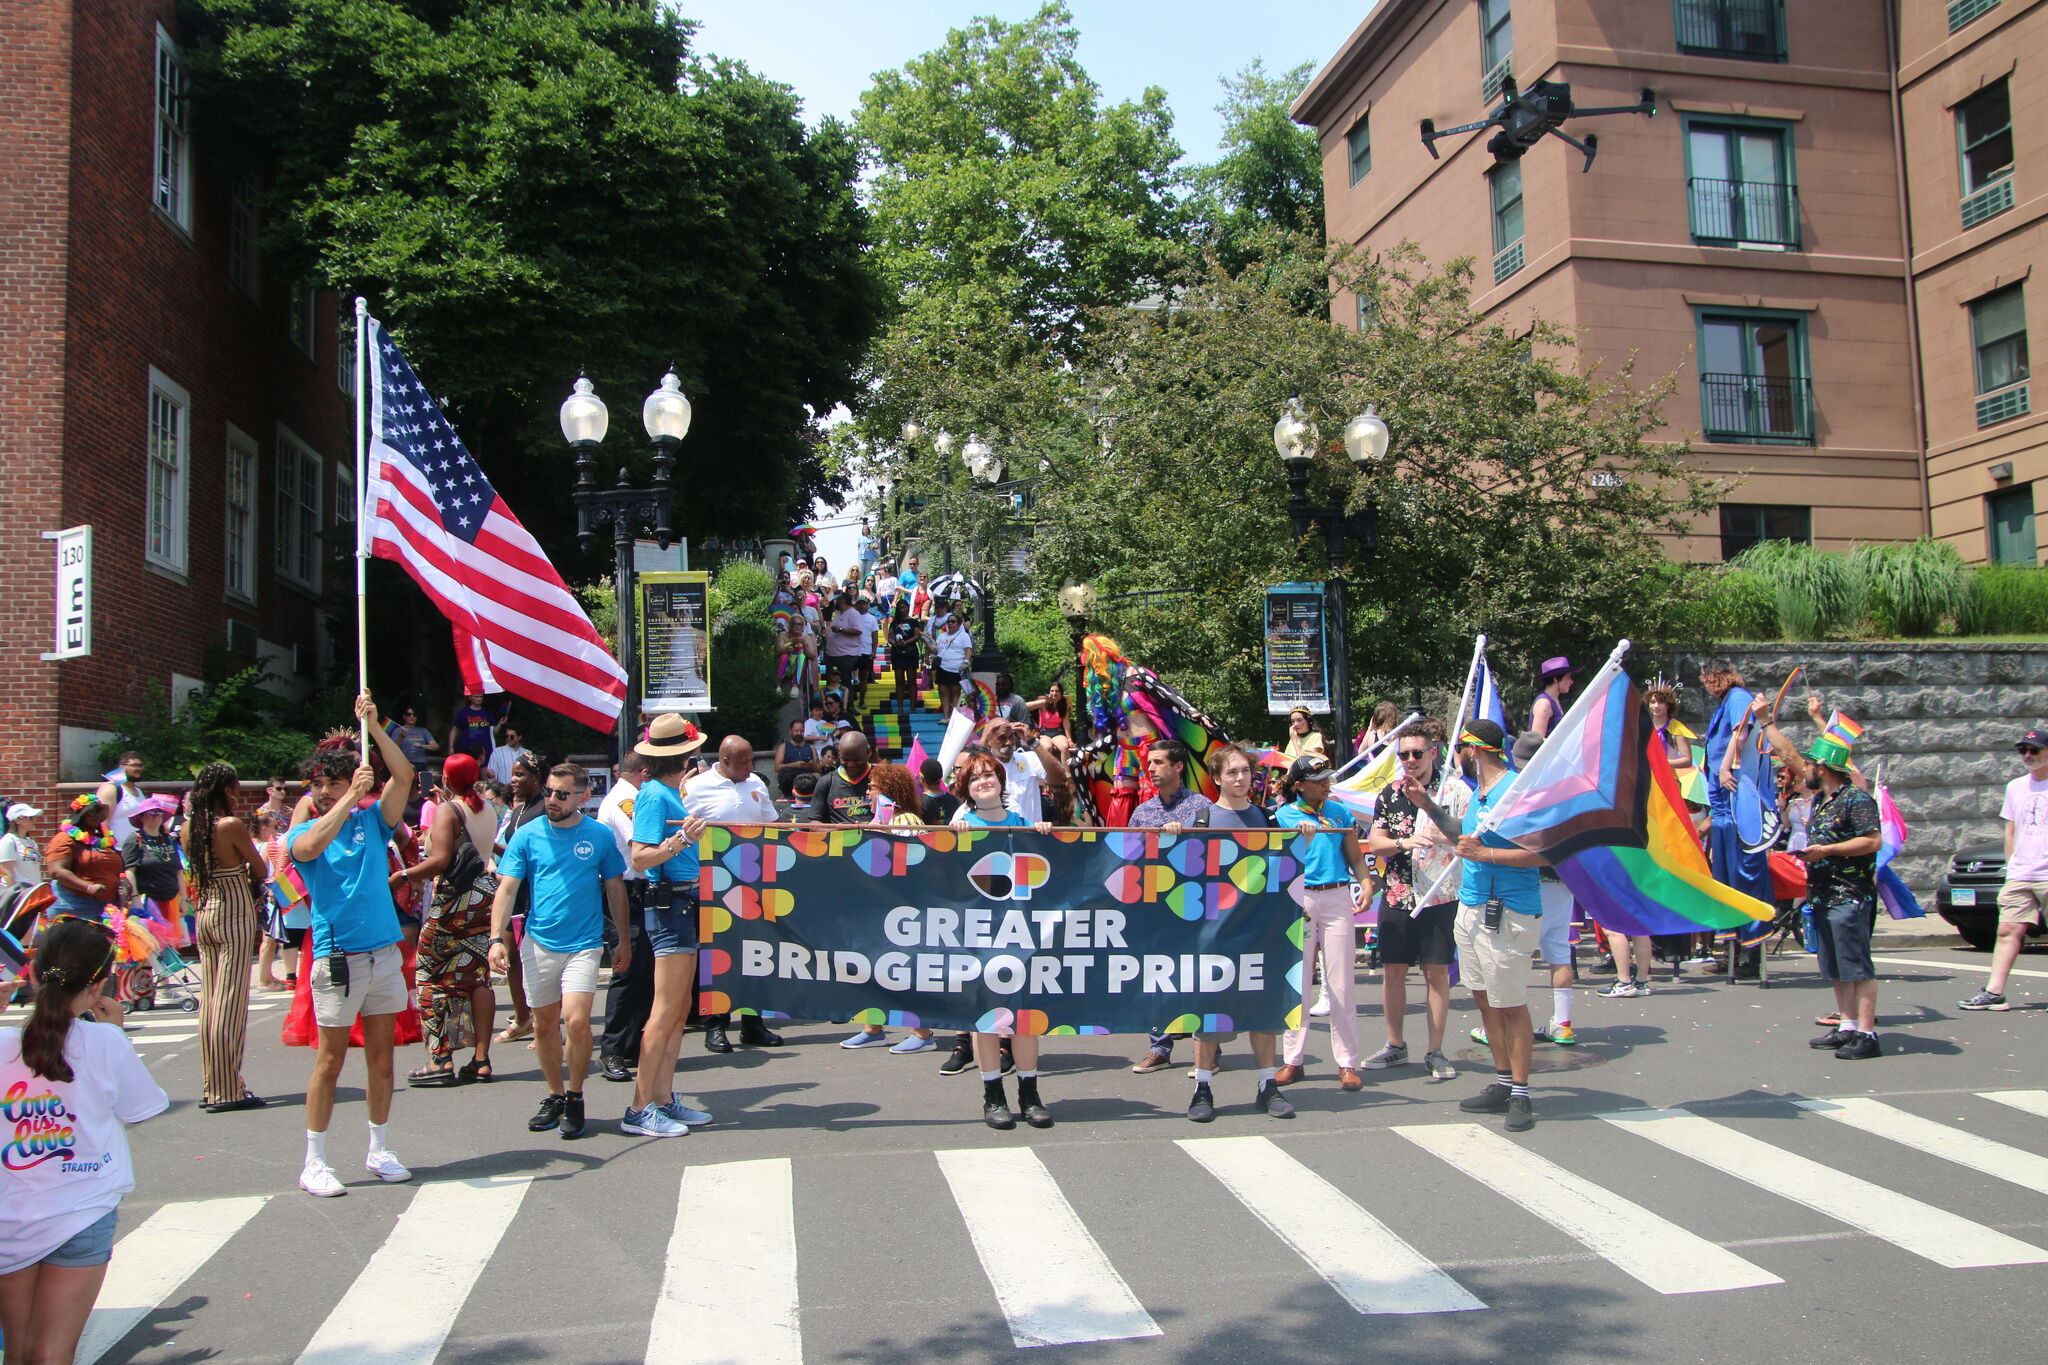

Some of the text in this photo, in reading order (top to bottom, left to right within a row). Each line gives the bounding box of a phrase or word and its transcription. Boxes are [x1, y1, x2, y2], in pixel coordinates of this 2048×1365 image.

[62, 545, 84, 567] 130
[67, 577, 83, 649] Elm
[884, 907, 1128, 950] GREATER
[741, 940, 1265, 996] BRIDGEPORT PRIDE
[33, 1114, 55, 1132] is
[62, 1161, 103, 1173] STRATFO
